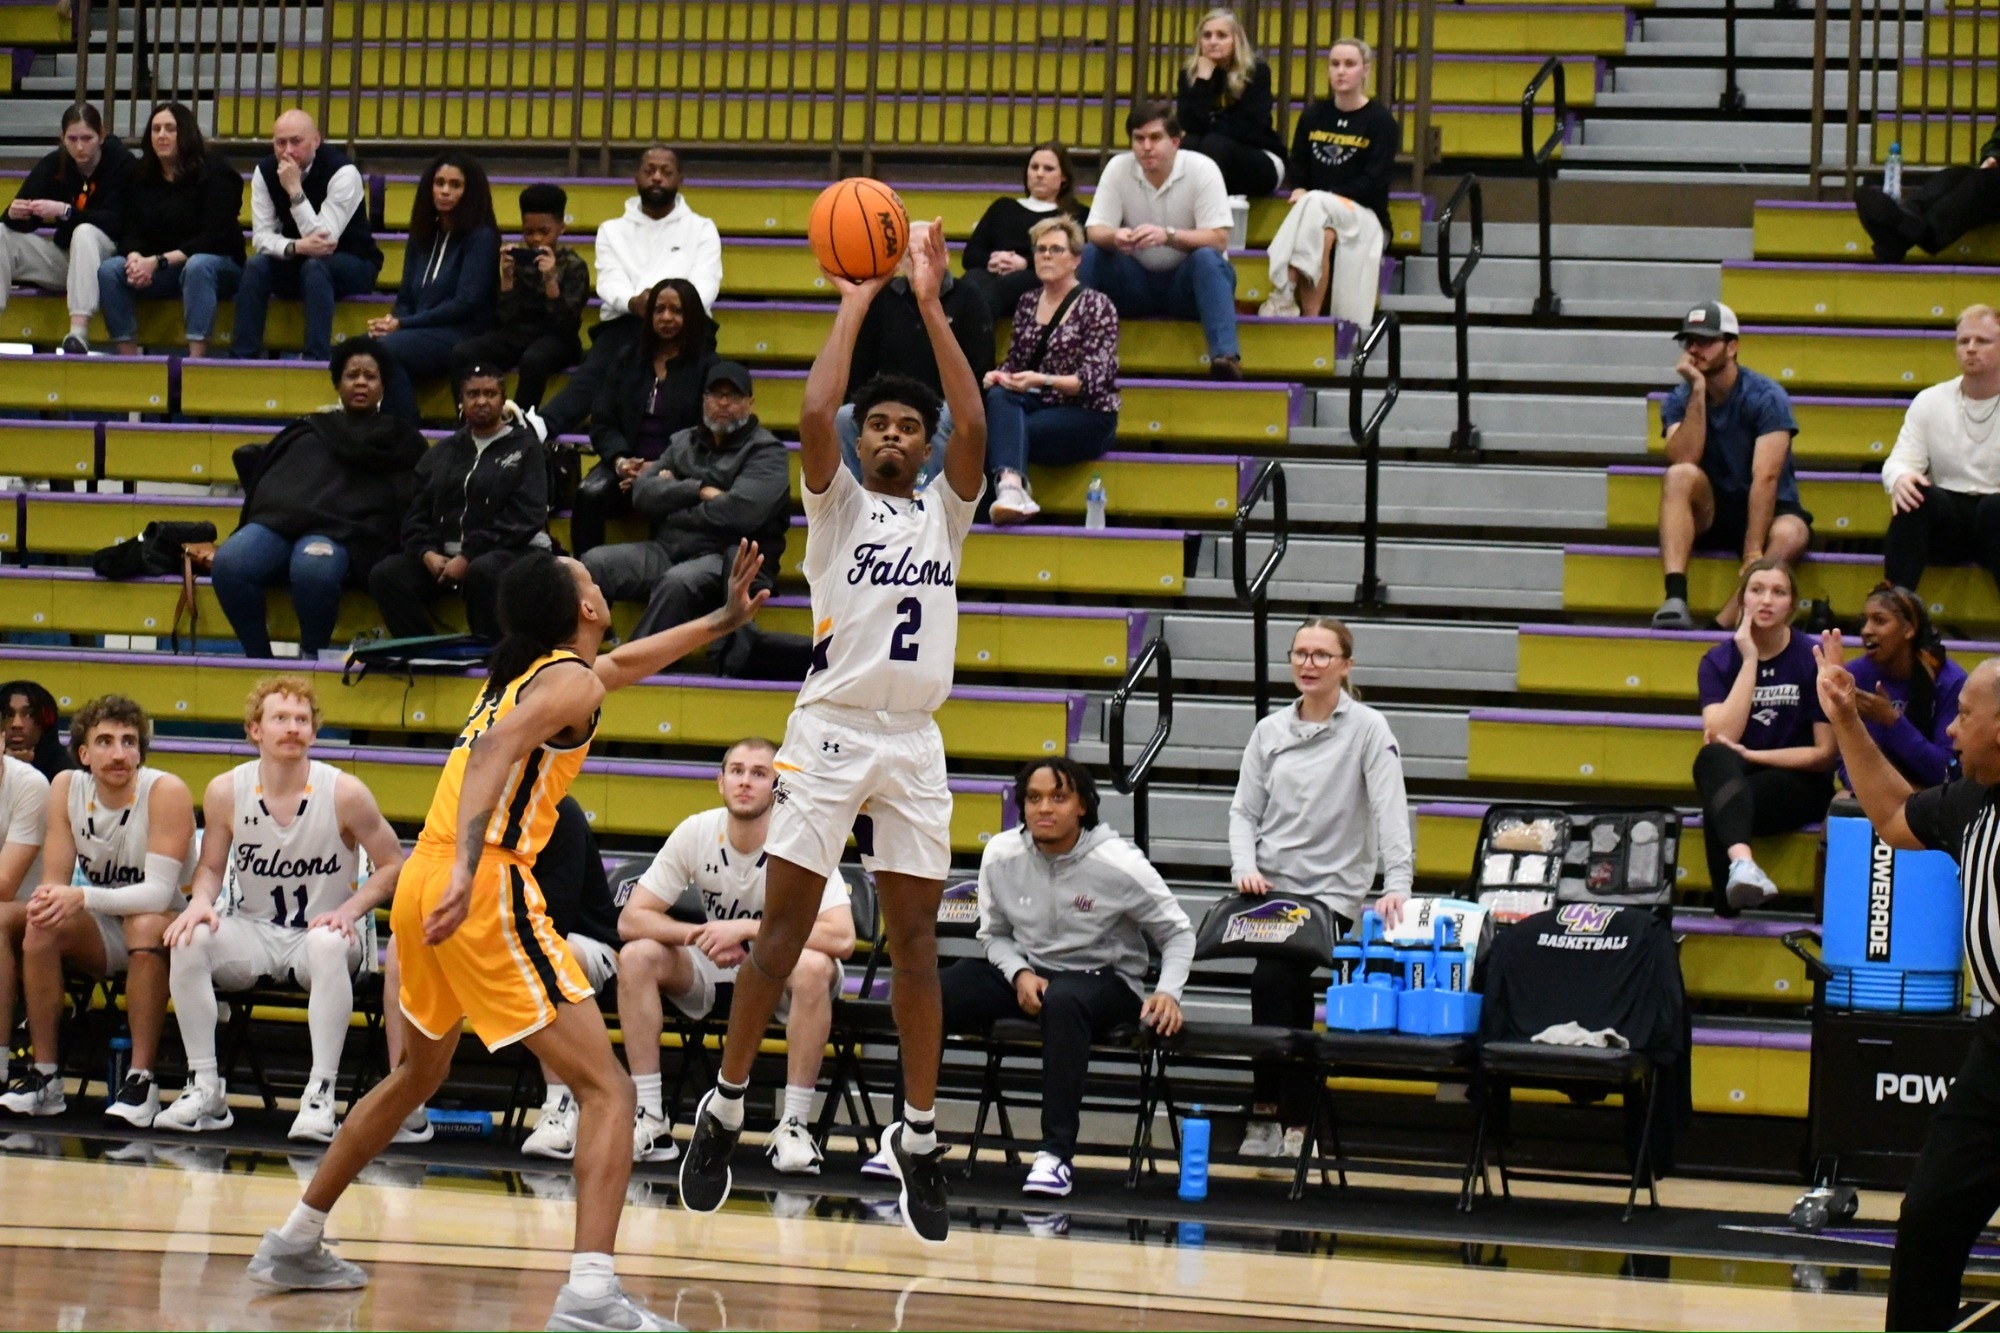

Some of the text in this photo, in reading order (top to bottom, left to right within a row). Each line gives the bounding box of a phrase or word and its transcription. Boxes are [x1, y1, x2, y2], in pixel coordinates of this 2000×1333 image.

[877, 211, 898, 258] NCAA
[847, 542, 954, 587] Falcons
[889, 596, 922, 662] 2
[236, 842, 341, 878] Falcons
[270, 884, 308, 928] 11
[1557, 903, 1611, 934] UM
[1537, 933, 1629, 951] BASKETBALL
